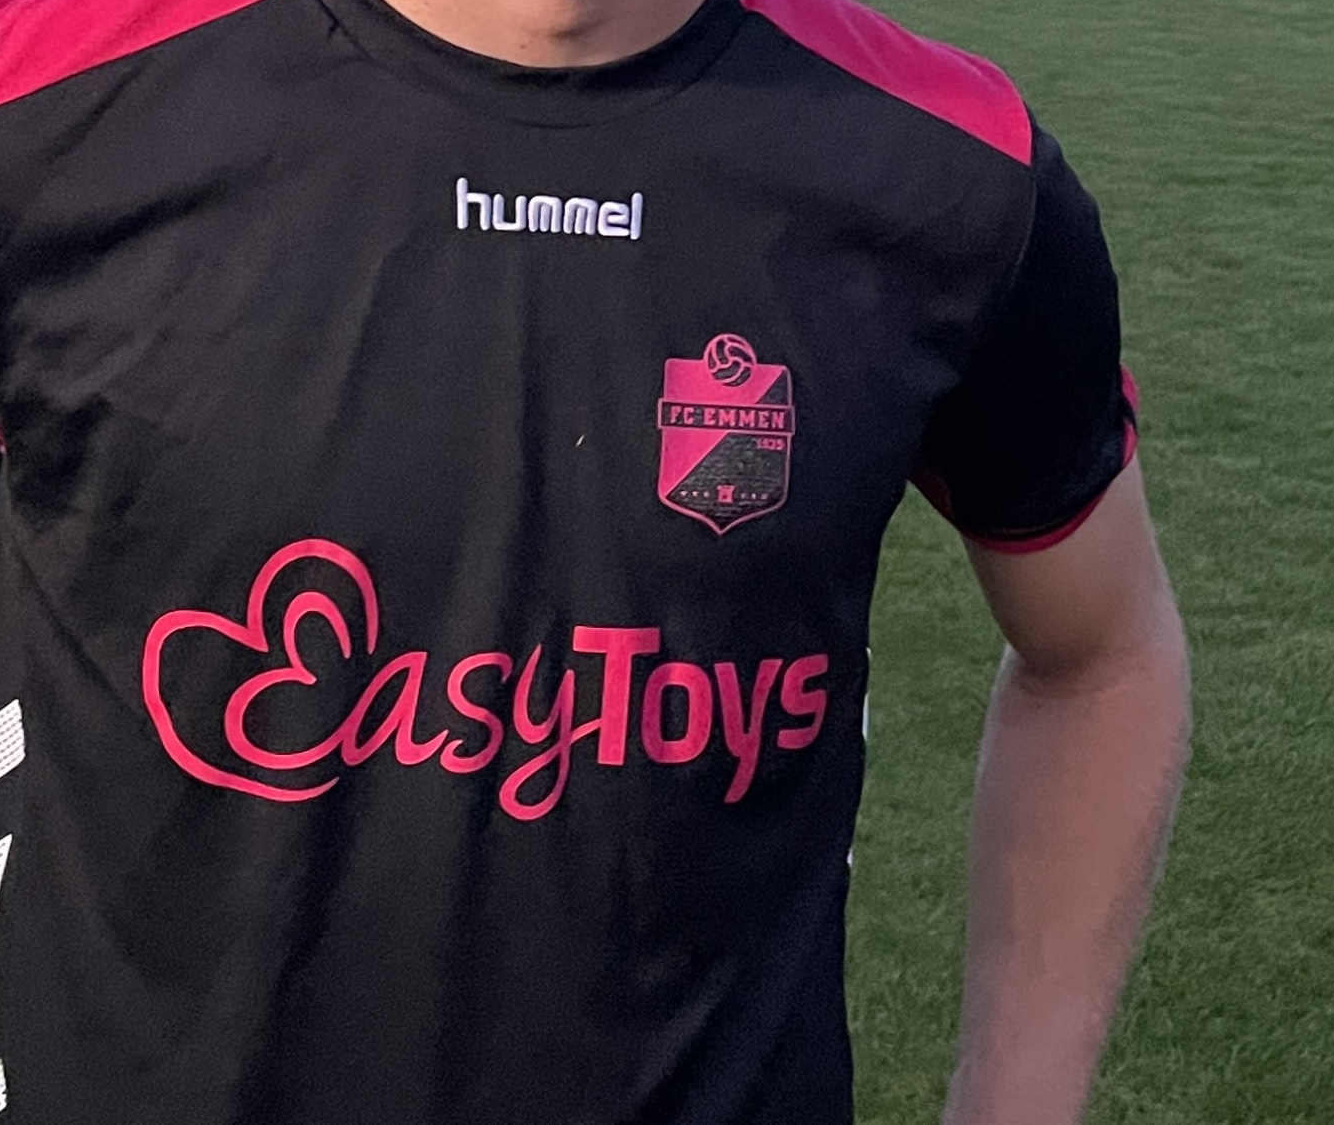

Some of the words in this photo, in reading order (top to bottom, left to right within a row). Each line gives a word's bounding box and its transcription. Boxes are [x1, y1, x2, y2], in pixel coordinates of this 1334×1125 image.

[456, 177, 643, 239] hummel
[670, 405, 695, 425] FC
[703, 407, 785, 429] EMMEN
[142, 538, 828, 820] EasyToys
